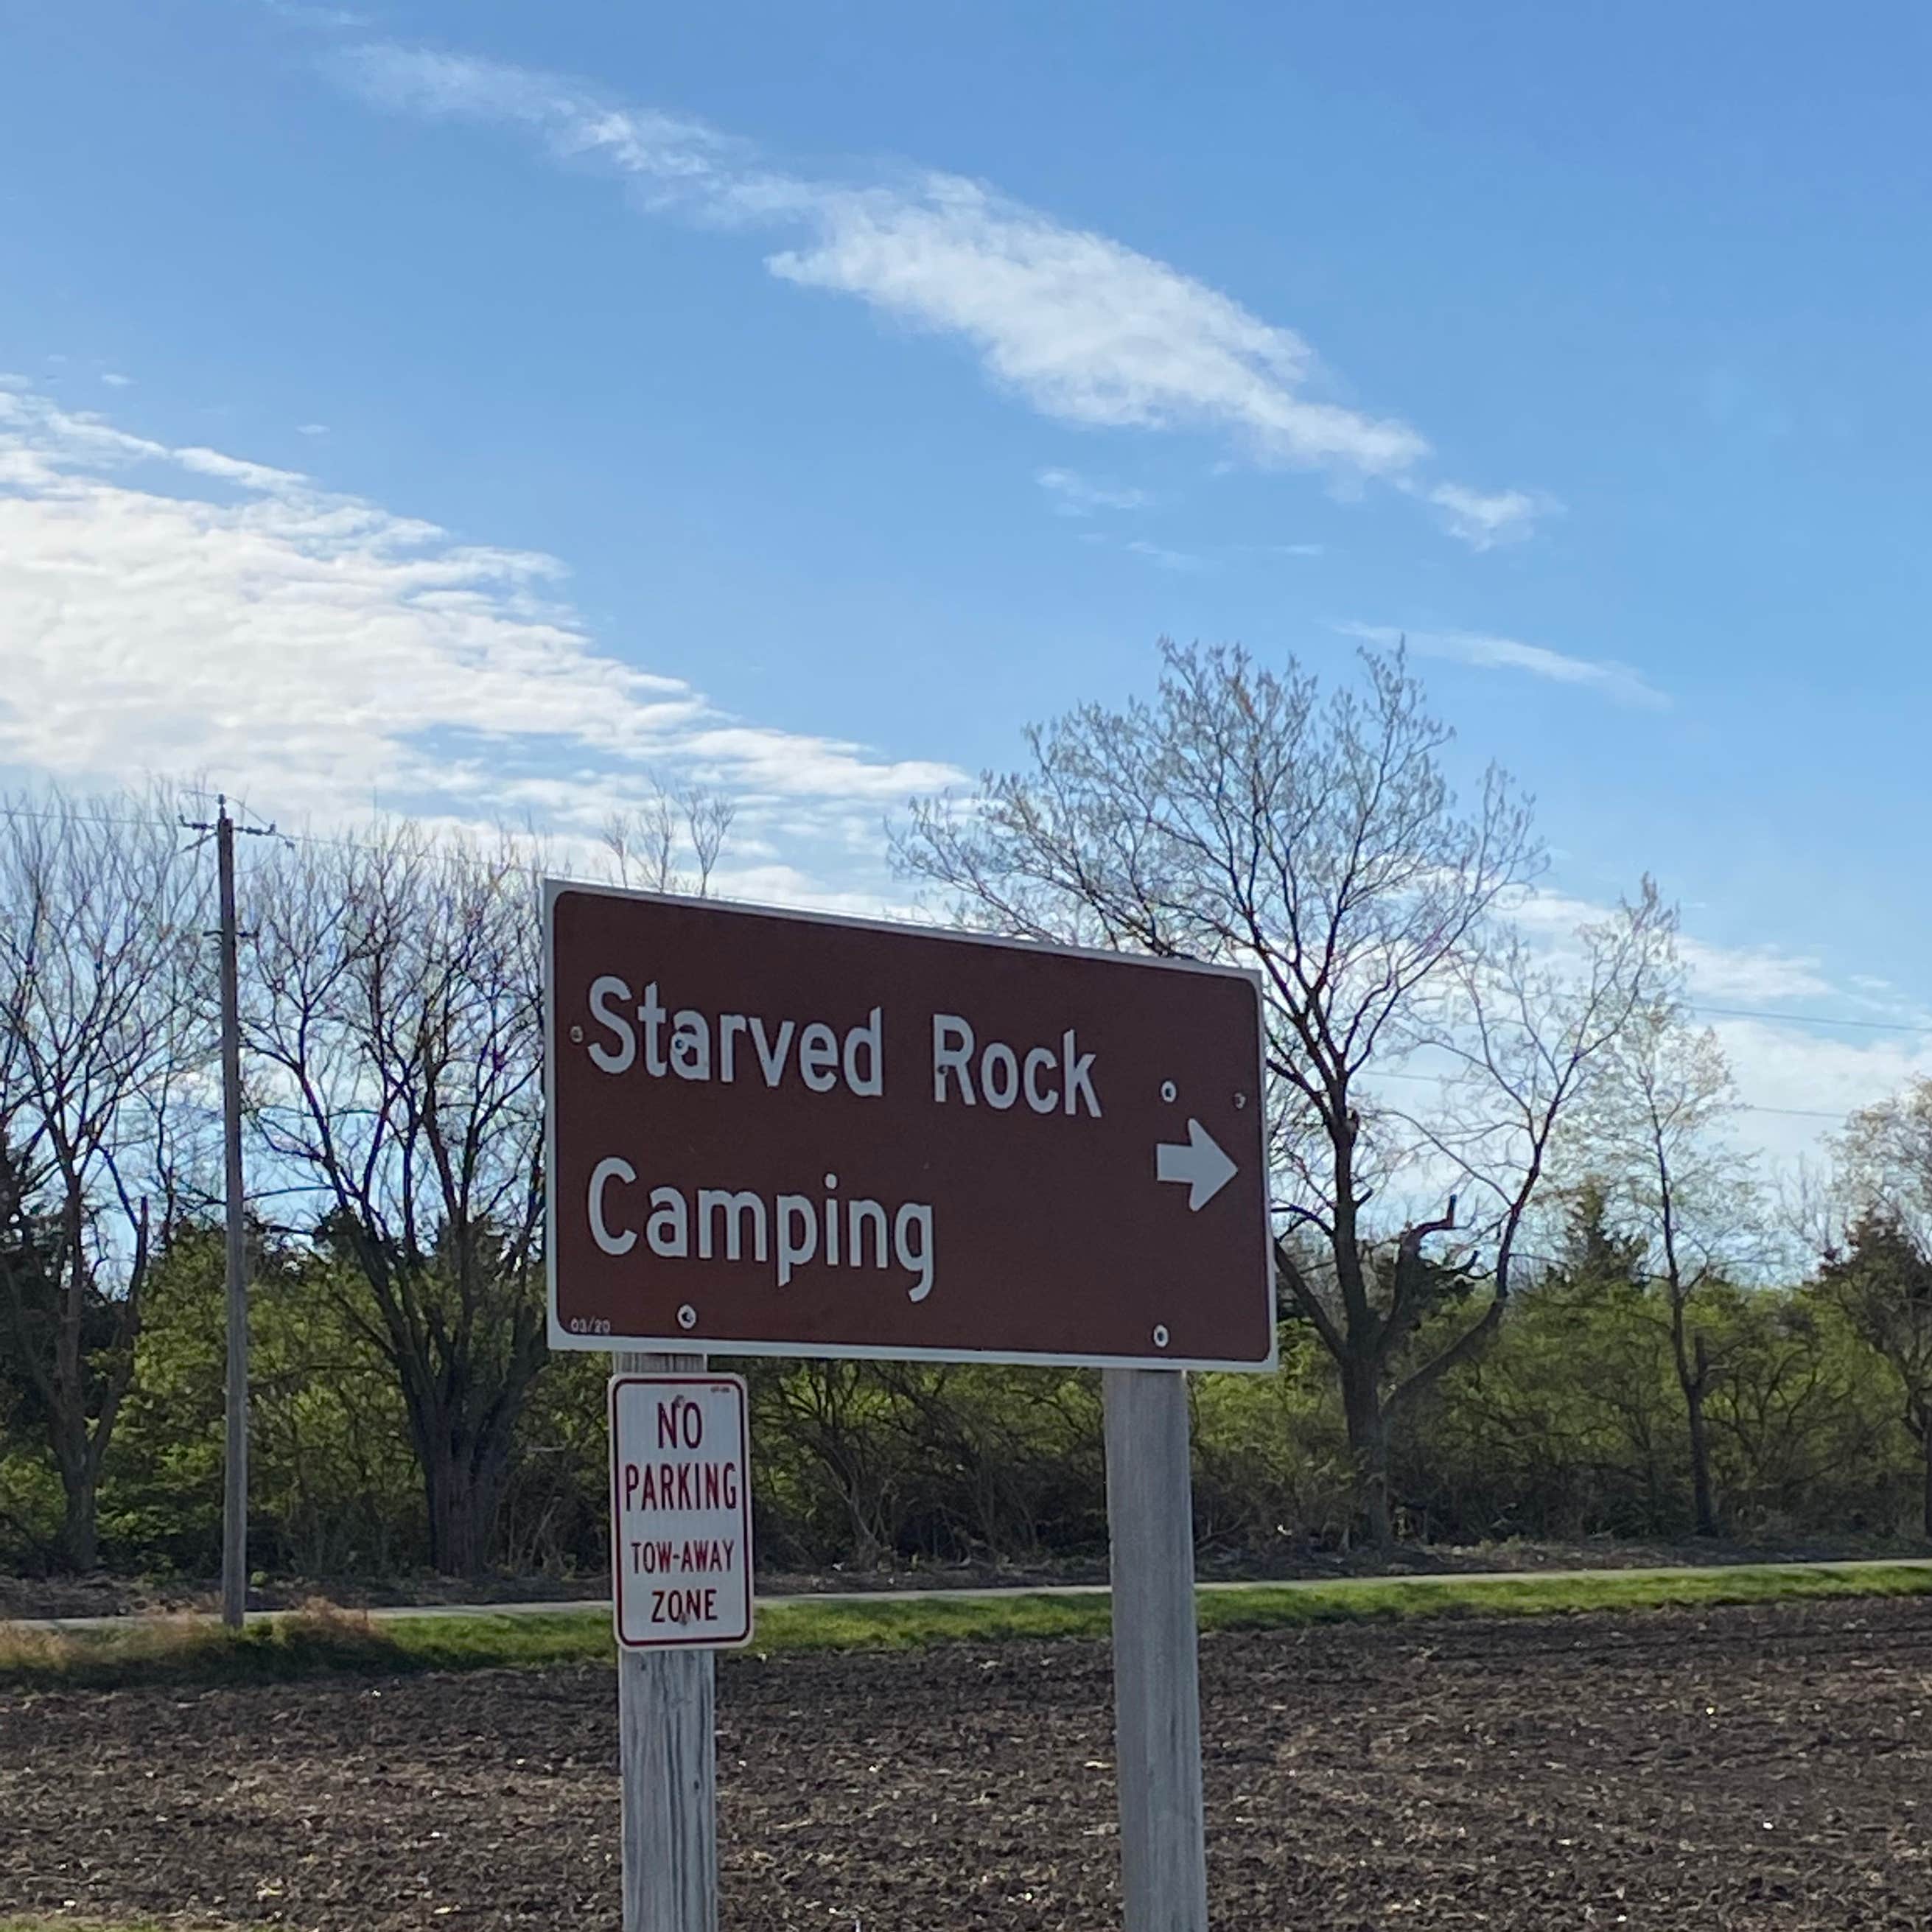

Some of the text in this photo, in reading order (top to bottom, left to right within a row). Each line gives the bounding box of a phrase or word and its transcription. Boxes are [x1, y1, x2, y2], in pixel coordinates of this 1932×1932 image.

[587, 976, 1102, 1118] Starved Rock
[588, 1156, 934, 1302] Camping
[657, 1401, 702, 1449] NO
[625, 1462, 737, 1511] PARKING
[631, 1540, 735, 1573] TOW-AWAY
[651, 1589, 718, 1623] ZONE
